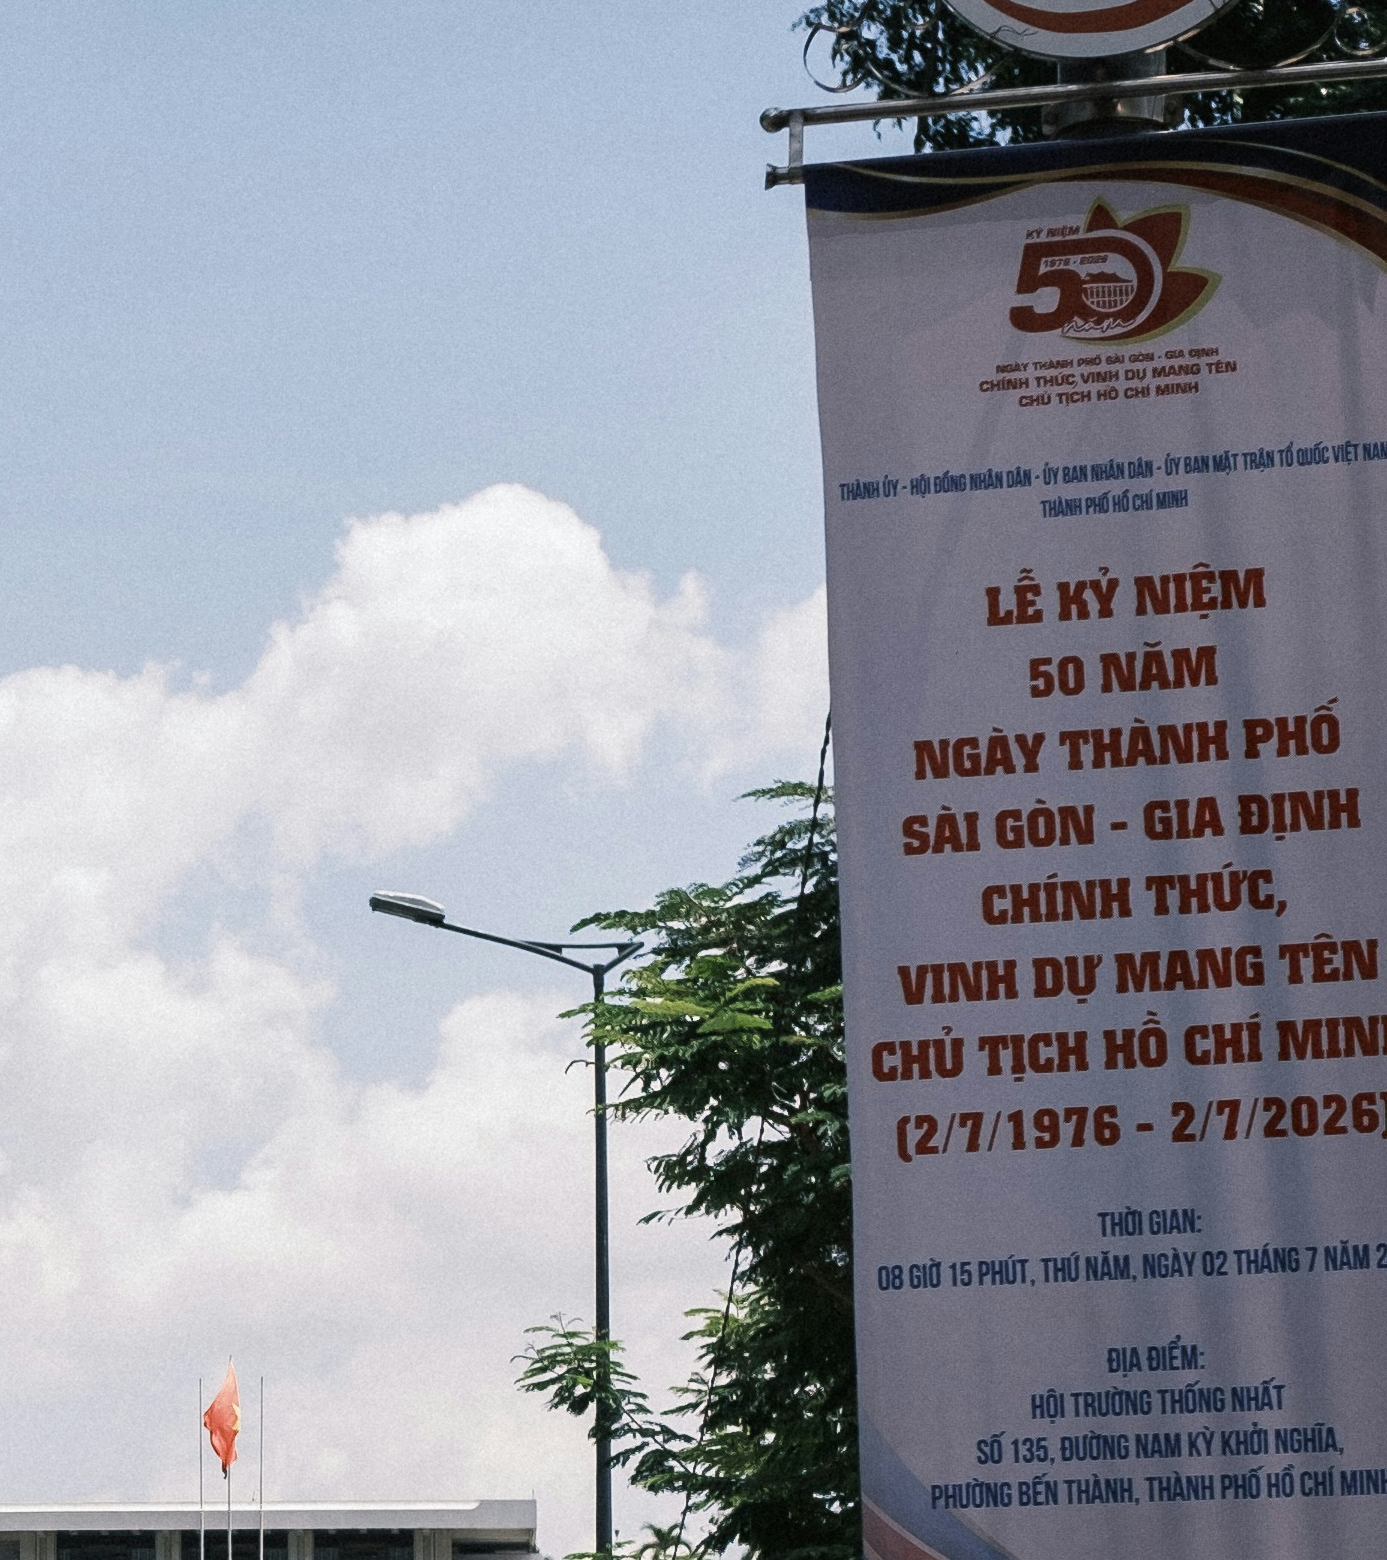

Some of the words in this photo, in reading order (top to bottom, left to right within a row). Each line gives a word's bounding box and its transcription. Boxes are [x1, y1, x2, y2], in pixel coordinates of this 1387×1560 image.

[979, 375, 1029, 393] CHÍNH
[1079, 369, 1120, 385] VINH
[1152, 361, 1201, 378] MANG
[1206, 358, 1237, 375] TÊN
[1165, 348, 1185, 361] GIA
[1019, 389, 1051, 408] CHỦ
[1056, 389, 1091, 407] TỊCH
[1123, 381, 1150, 398] CHÍ
[1155, 381, 1200, 397] MINH
[839, 479, 880, 501] THÀNH
[910, 473, 931, 499] HỘI
[969, 467, 1003, 492] NHÂN
[1006, 466, 1032, 489] DÂN
[1062, 463, 1087, 484] BAN
[1090, 458, 1125, 482] NHÂN
[1127, 456, 1154, 480] DÂN
[1184, 455, 1209, 475] BAN
[1212, 449, 1239, 476] MẶT
[1242, 446, 1275, 473] TRẬN
[1277, 441, 1294, 469] TỔ
[1296, 441, 1330, 467] QUỐC
[1332, 440, 1360, 466] VIỆT
[1040, 495, 1083, 519] THÀNH
[1085, 491, 1109, 515] PHỐ
[1112, 488, 1130, 514] HỒ
[1132, 489, 1154, 512] CHÍ
[1156, 489, 1189, 511] MINH
[986, 568, 1043, 626] LỄ
[1057, 567, 1119, 621] KỶ
[1134, 563, 1266, 619] NIỆM
[1030, 656, 1085, 698] 50
[1100, 642, 1218, 693] NĂM
[914, 728, 1045, 780] NGÀY
[1060, 718, 1229, 771] THÀNH
[1243, 698, 1340, 759] PHỐ
[903, 806, 980, 855] SÀI
[995, 799, 1094, 849] GÒN
[1111, 822, 1127, 830] -
[1144, 797, 1224, 840] GIA
[1238, 788, 1360, 840] ĐỊNH
[982, 873, 1132, 925] CHÍNH
[1146, 863, 1286, 917] THỨC,
[898, 960, 1018, 1005] VINH
[1033, 955, 1102, 1003] DỰ
[1115, 946, 1265, 993] MANG
[1279, 933, 1378, 984] TÊN
[872, 1026, 964, 1081] CHỦ
[979, 1031, 1089, 1081] TỊCH
[1103, 1011, 1167, 1069] HỒ
[1184, 1013, 1262, 1065] CHÍ
[1276, 1015, 1387, 1061] MIN
[897, 1105, 1120, 1162] (2/7/1976
[1097, 1206, 1143, 1237] THỜI
[1149, 1209, 1202, 1235] GIAN:
[878, 1265, 903, 1291] 08
[909, 1258, 941, 1289] GIỜ
[949, 1262, 972, 1286] 15
[978, 1255, 1035, 1286] PHÚT,
[1040, 1252, 1080, 1283] THỨ
[1085, 1251, 1137, 1281] NĂM,
[1143, 1248, 1196, 1279] NGÀY
[1202, 1251, 1228, 1276] 02
[1233, 1243, 1300, 1275] THÁNG
[1305, 1247, 1317, 1272] 7
[1324, 1240, 1370, 1271] NĂM
[1107, 1347, 1142, 1377] ĐỊA
[1146, 1335, 1205, 1371] ĐIỂM:
[1031, 1389, 1065, 1424] HỘI
[1071, 1386, 1152, 1417] TRƯỜNG
[1157, 1381, 1225, 1414] THỐNG
[1231, 1377, 1285, 1412] NHẤT
[977, 1431, 1005, 1464] SỐ
[1011, 1437, 1055, 1464] 135,
[1060, 1430, 1129, 1461] ĐƯỜNG
[1135, 1433, 1181, 1458] NAM
[1188, 1426, 1215, 1457] KỲ
[1221, 1422, 1268, 1456] KHỞI
[1275, 1423, 1343, 1454] NGHĨA,
[931, 1478, 1012, 1510] PHƯỜNG
[1018, 1473, 1058, 1506] BẾN
[1064, 1474, 1139, 1505] THÀNH,
[1145, 1471, 1214, 1502] THÀNH
[1221, 1466, 1262, 1499] PHỐ
[1267, 1464, 1294, 1498] HỒ
[1300, 1466, 1334, 1497] CHÍ
